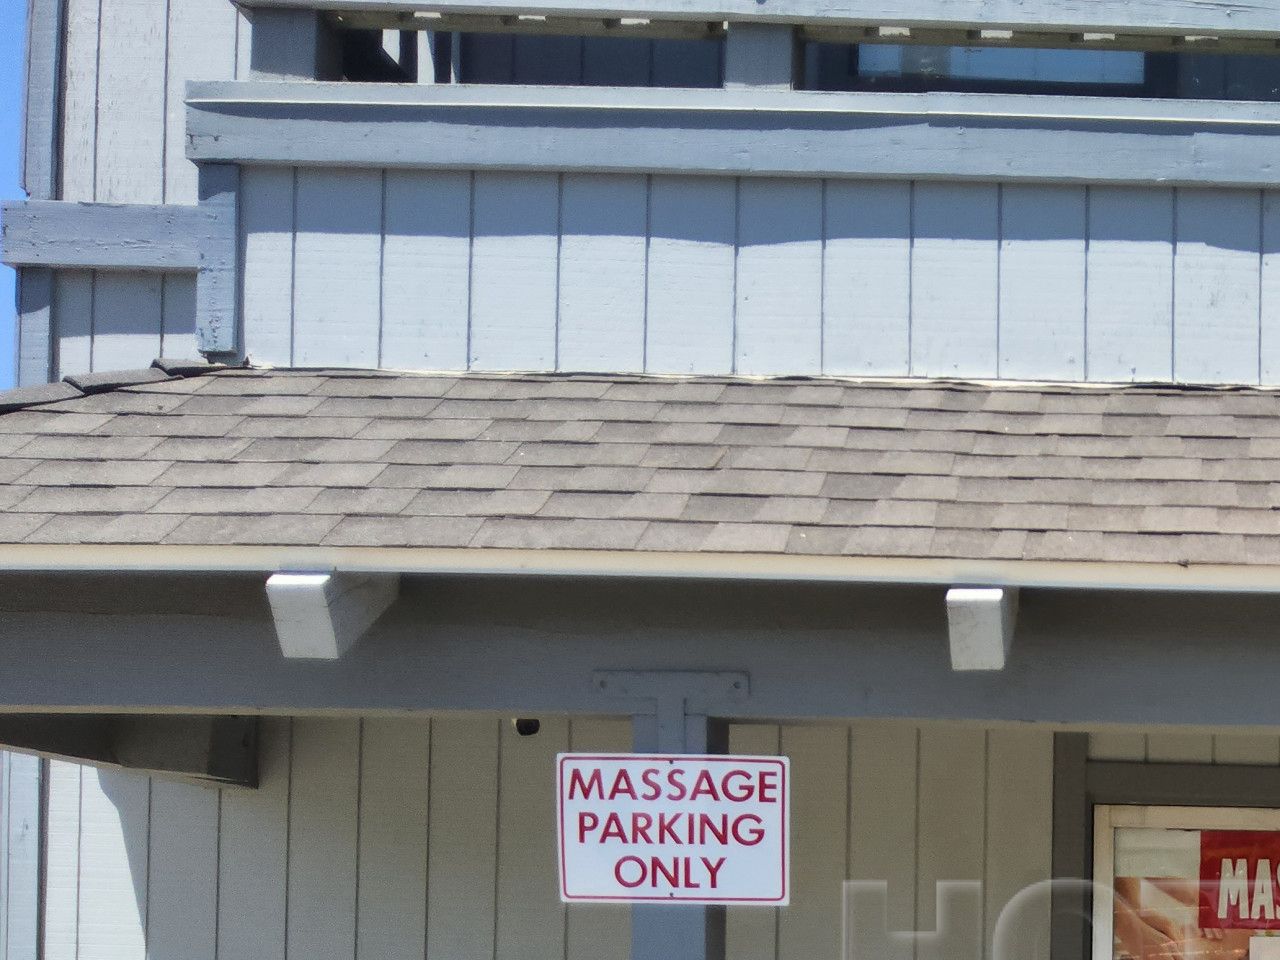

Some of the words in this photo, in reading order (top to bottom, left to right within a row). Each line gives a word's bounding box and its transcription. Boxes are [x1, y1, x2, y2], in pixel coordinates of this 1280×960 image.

[568, 768, 777, 803] MASSAGE
[578, 812, 765, 846] PARKING
[614, 855, 727, 889] ONLY
